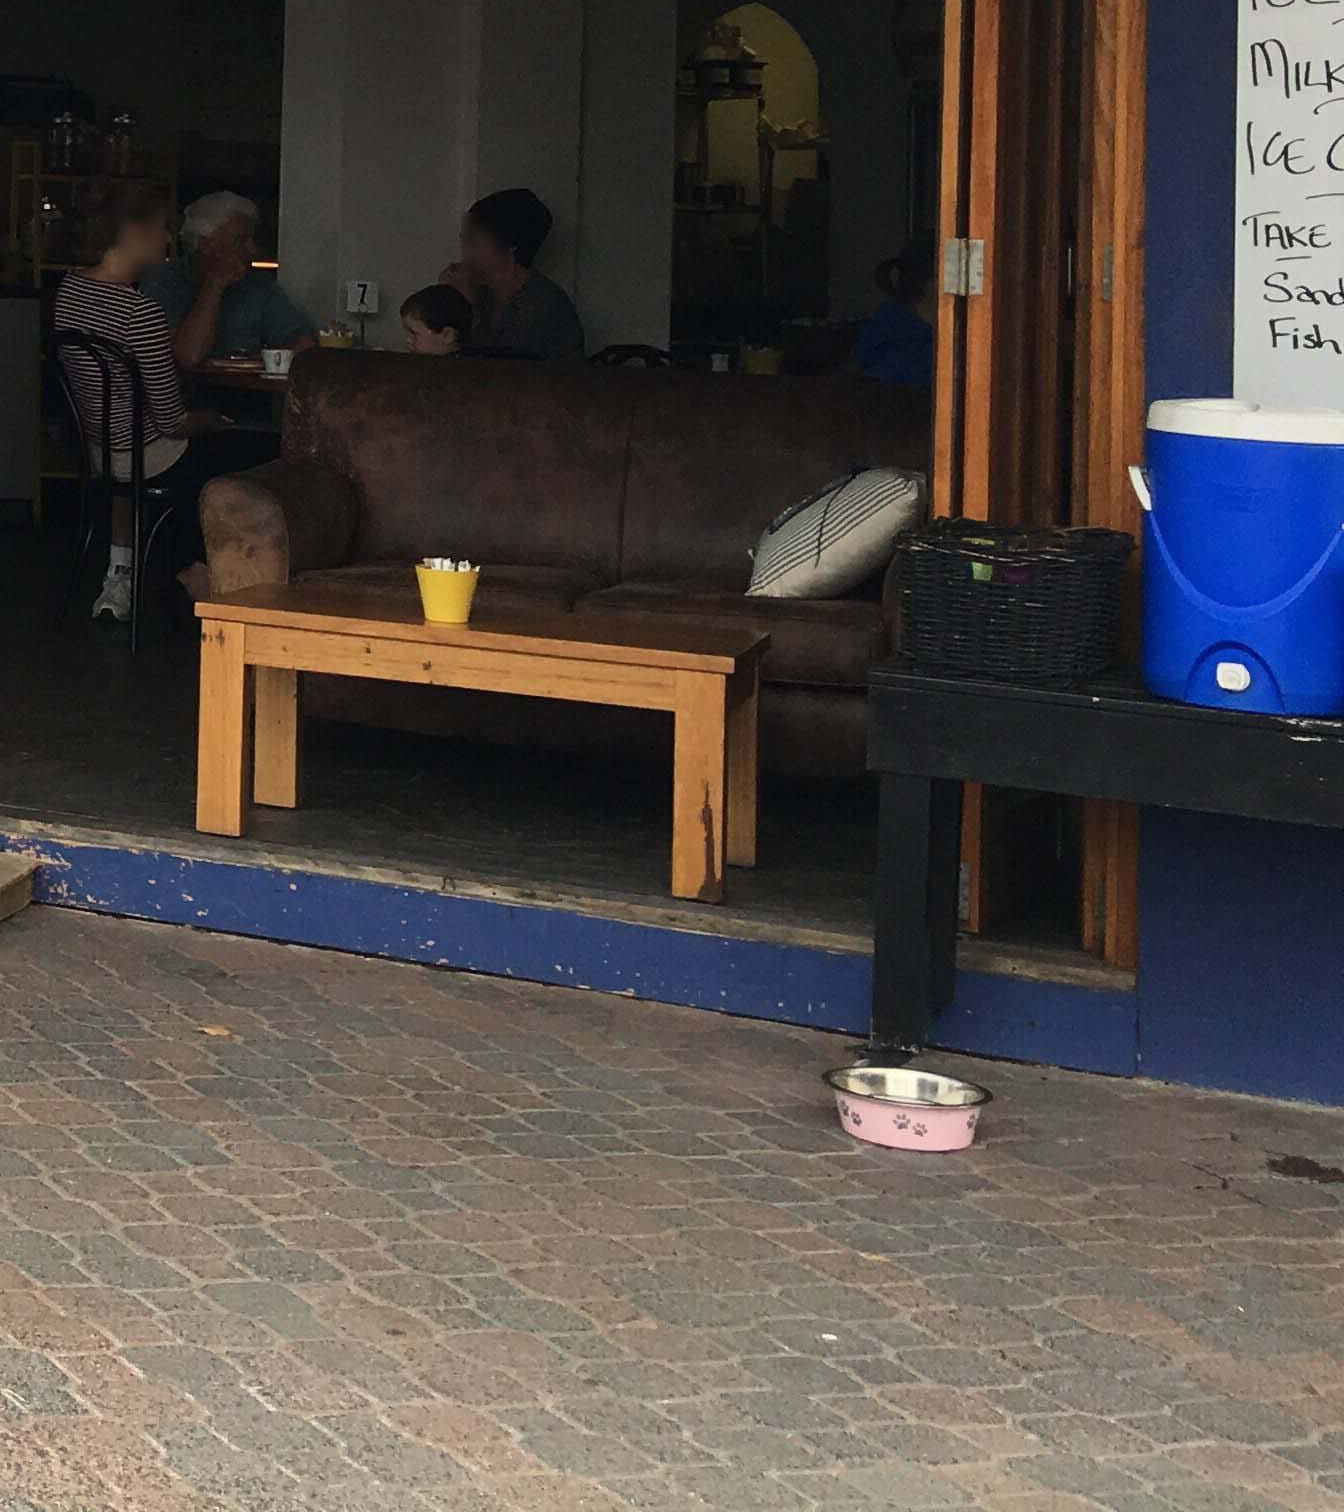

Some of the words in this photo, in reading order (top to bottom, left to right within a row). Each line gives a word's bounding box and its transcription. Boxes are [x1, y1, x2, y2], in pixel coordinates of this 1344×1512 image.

[1250, 38, 1344, 99] MILK
[1247, 121, 1315, 175] ICE
[1242, 211, 1332, 250] TAKE
[357, 283, 368, 304] 7
[1268, 317, 1343, 356] Fish
